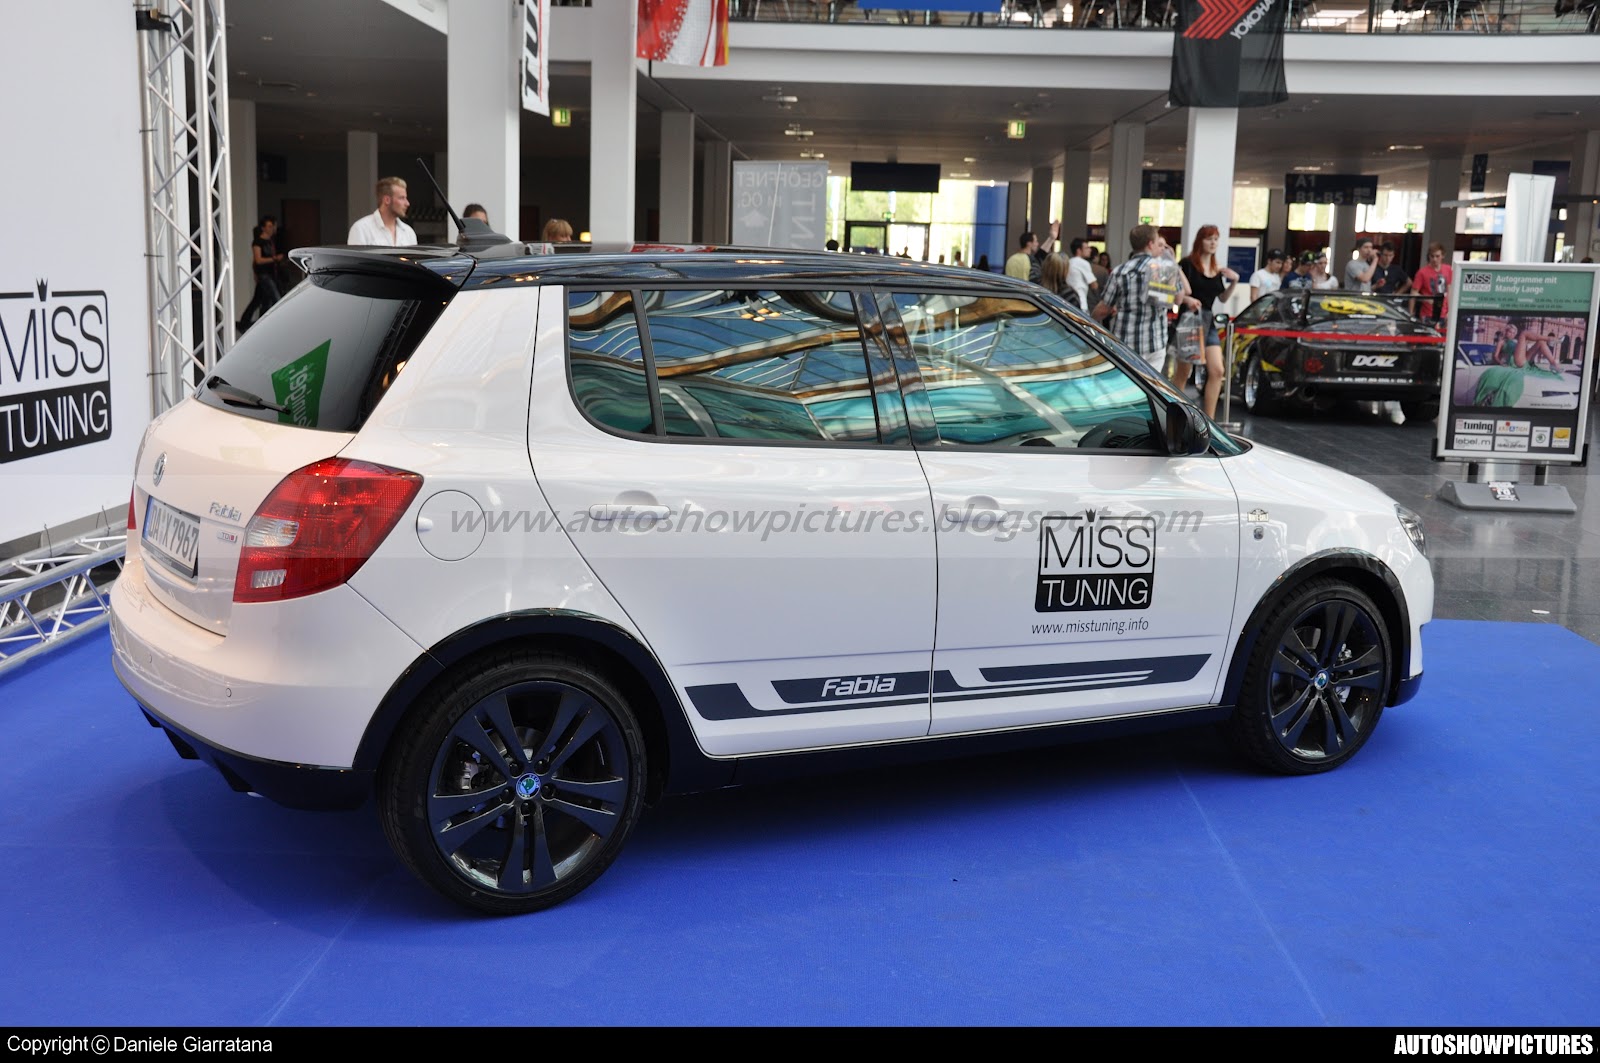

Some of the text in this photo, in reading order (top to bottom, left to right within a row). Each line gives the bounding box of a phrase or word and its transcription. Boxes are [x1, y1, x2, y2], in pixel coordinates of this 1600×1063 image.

[1295, 176, 1317, 188] A1
[1495, 285, 1544, 295] Mandy Lange
[1496, 276, 1558, 285] Autogramme mit
[0, 390, 109, 452] TUNING
[1464, 421, 1493, 432] tuning
[209, 502, 242, 522] Fabia
[170, 517, 200, 562] 7967
[1044, 525, 1150, 568] MISS
[1042, 578, 1148, 607] TUNING
[1032, 617, 1149, 635] www.misstuning.info
[821, 676, 897, 698] Fabia
